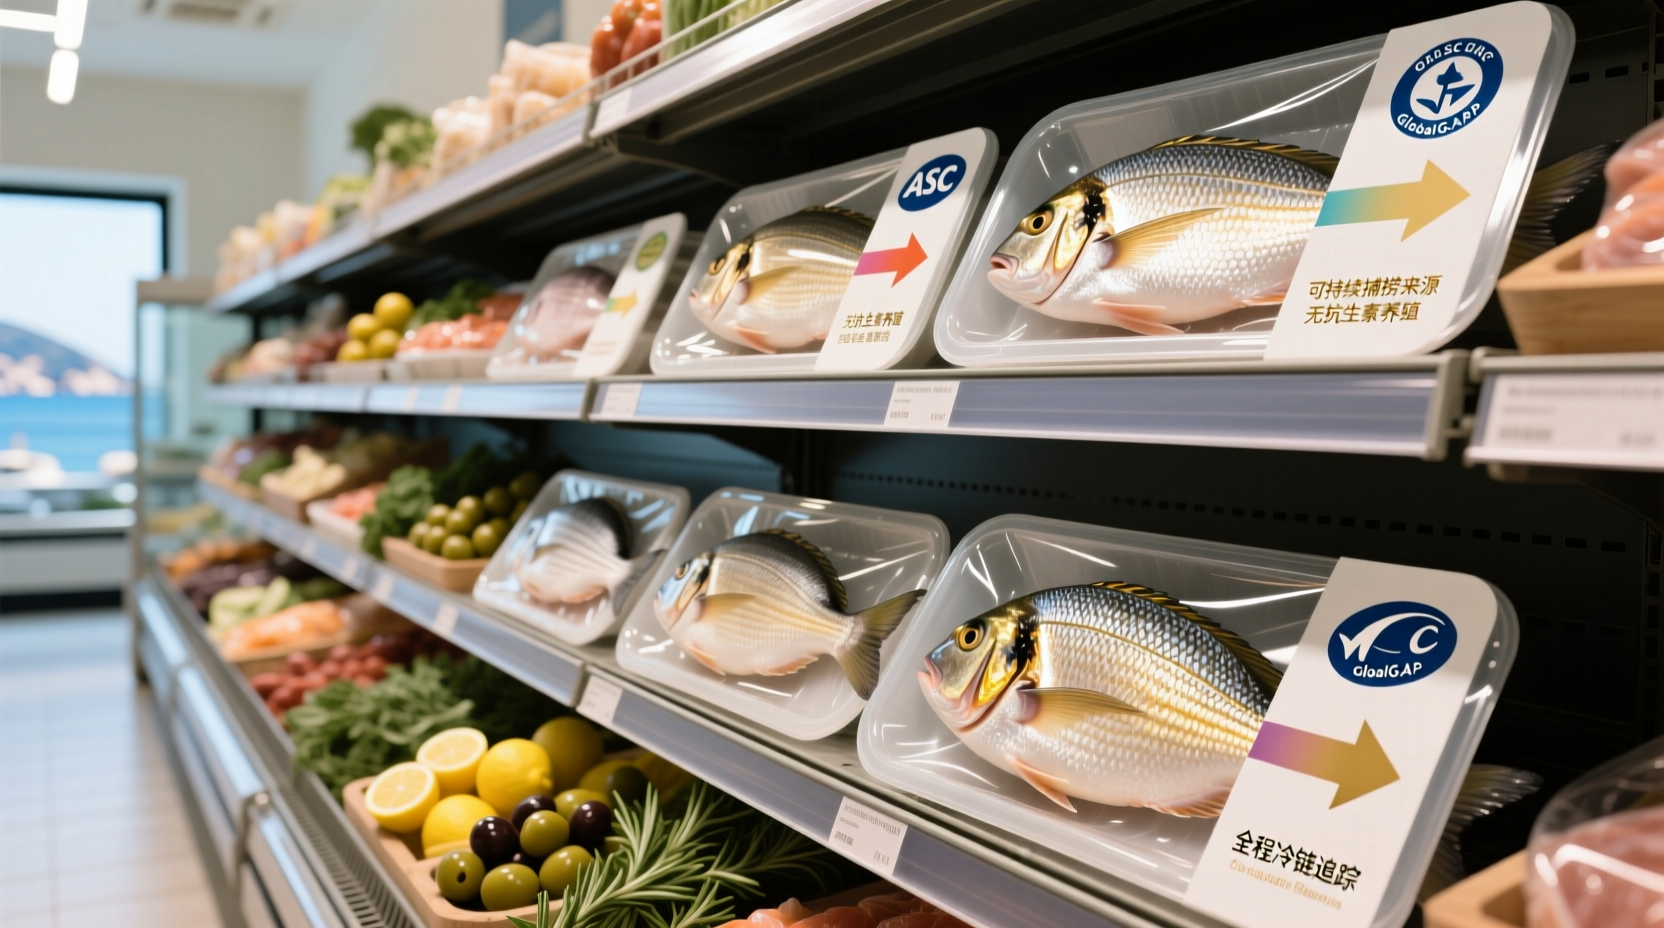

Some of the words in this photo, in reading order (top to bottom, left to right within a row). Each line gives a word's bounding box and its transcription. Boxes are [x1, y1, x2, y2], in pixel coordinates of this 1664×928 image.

[902, 164, 958, 199] ASC
[1309, 275, 1443, 300] 可持续捕捞来源
